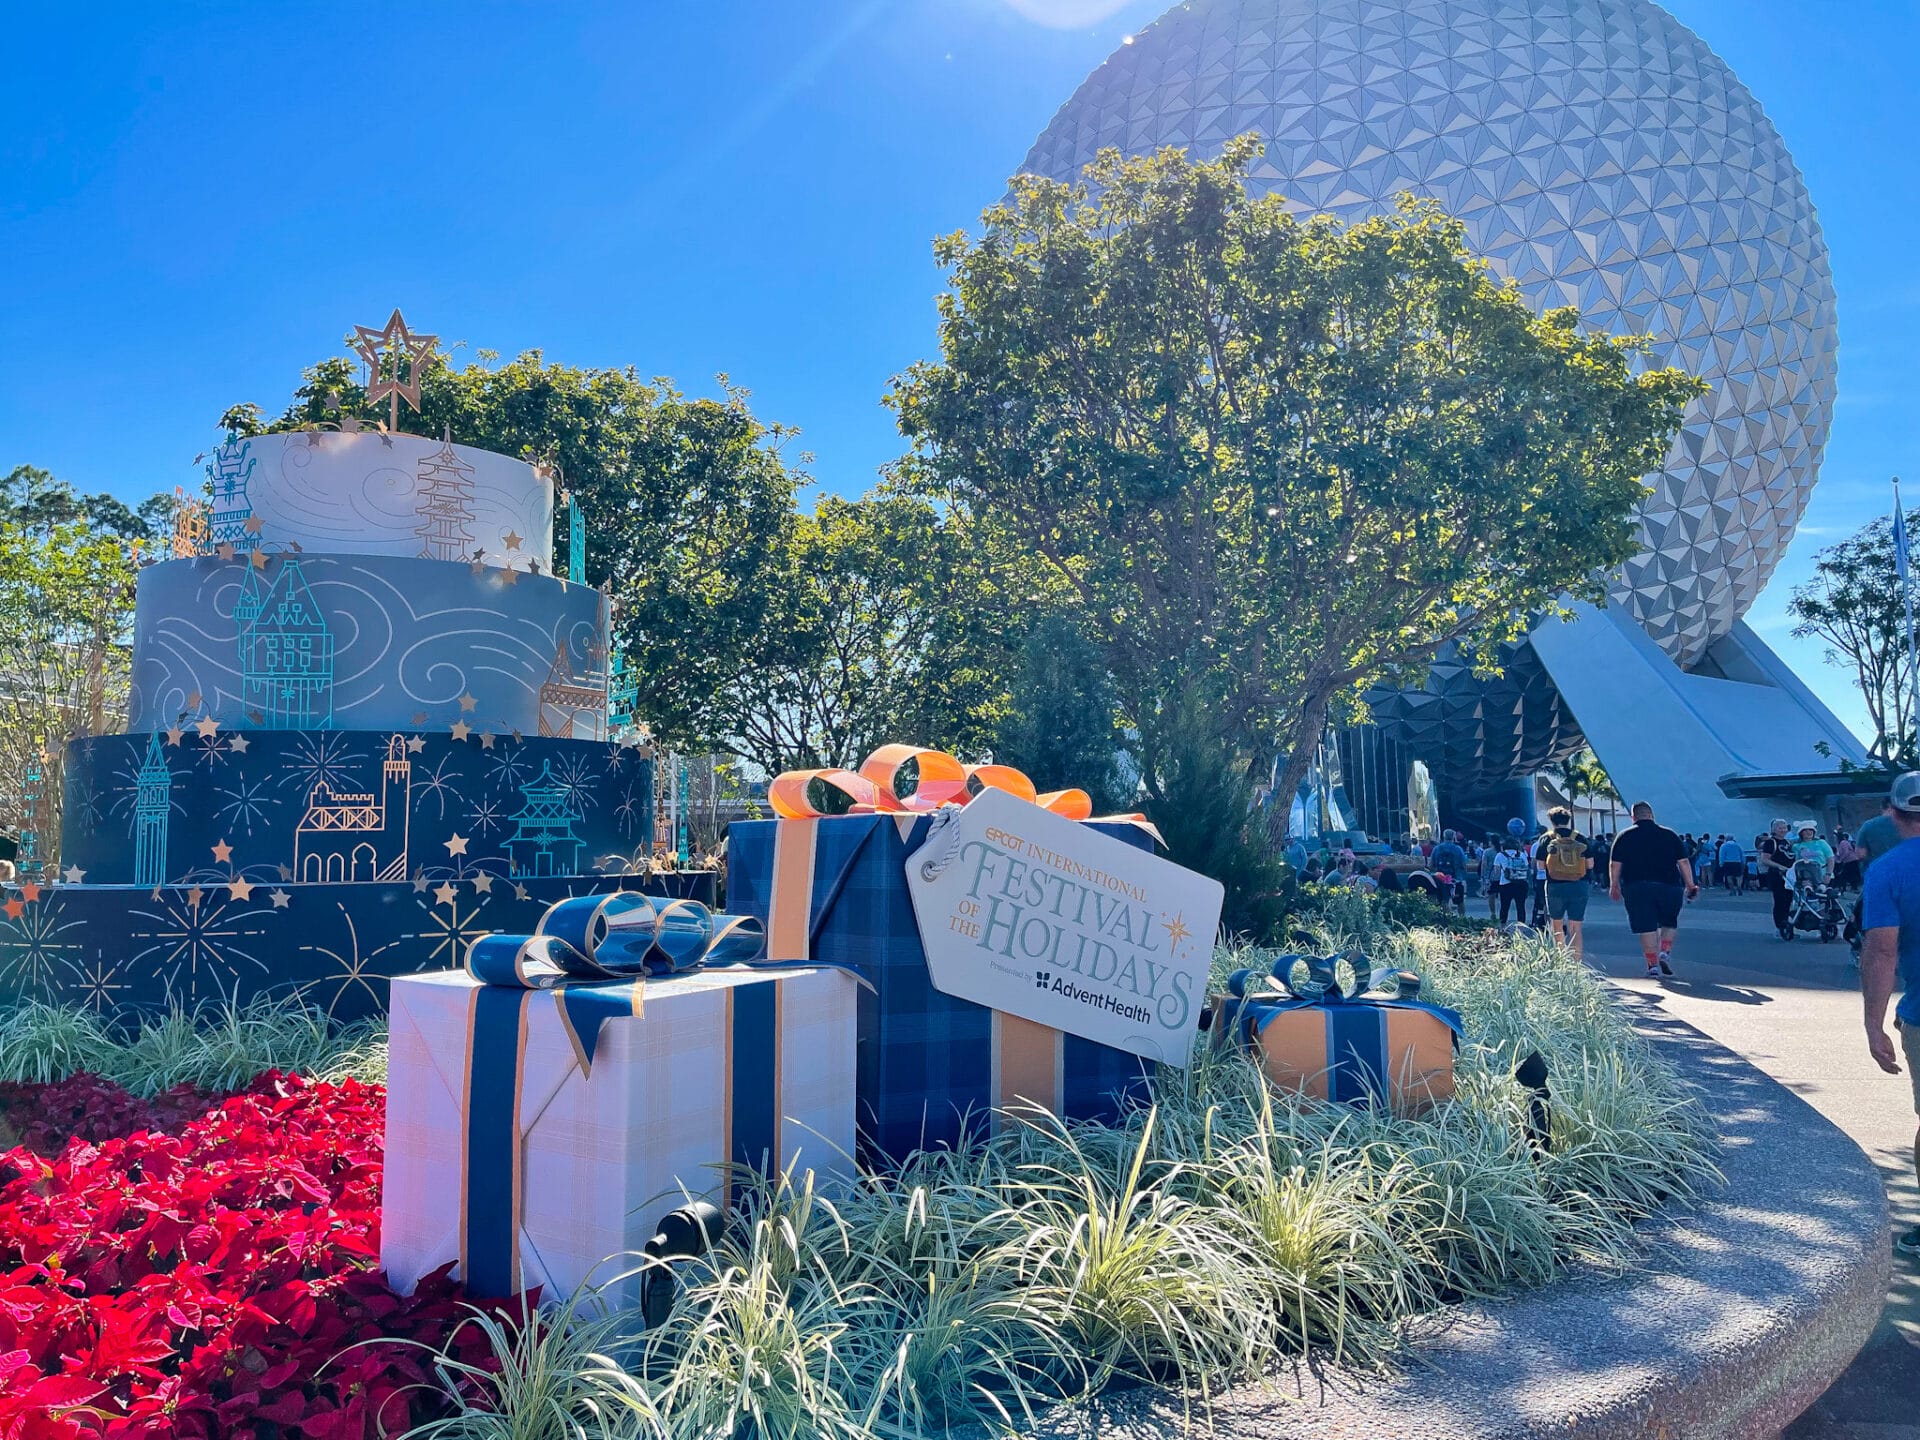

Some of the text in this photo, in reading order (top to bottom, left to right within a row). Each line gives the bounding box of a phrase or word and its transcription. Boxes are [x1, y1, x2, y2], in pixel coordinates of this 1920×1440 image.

[985, 827, 1146, 902] EPCOT INTERNATIONAL
[958, 900, 981, 918] OF
[959, 840, 1160, 953] FESTIVAL
[948, 915, 981, 939] THE
[976, 894, 1193, 1031] HOLIDAYS
[989, 960, 1022, 979] Presented
[1051, 976, 1151, 1025] AdventHealth
